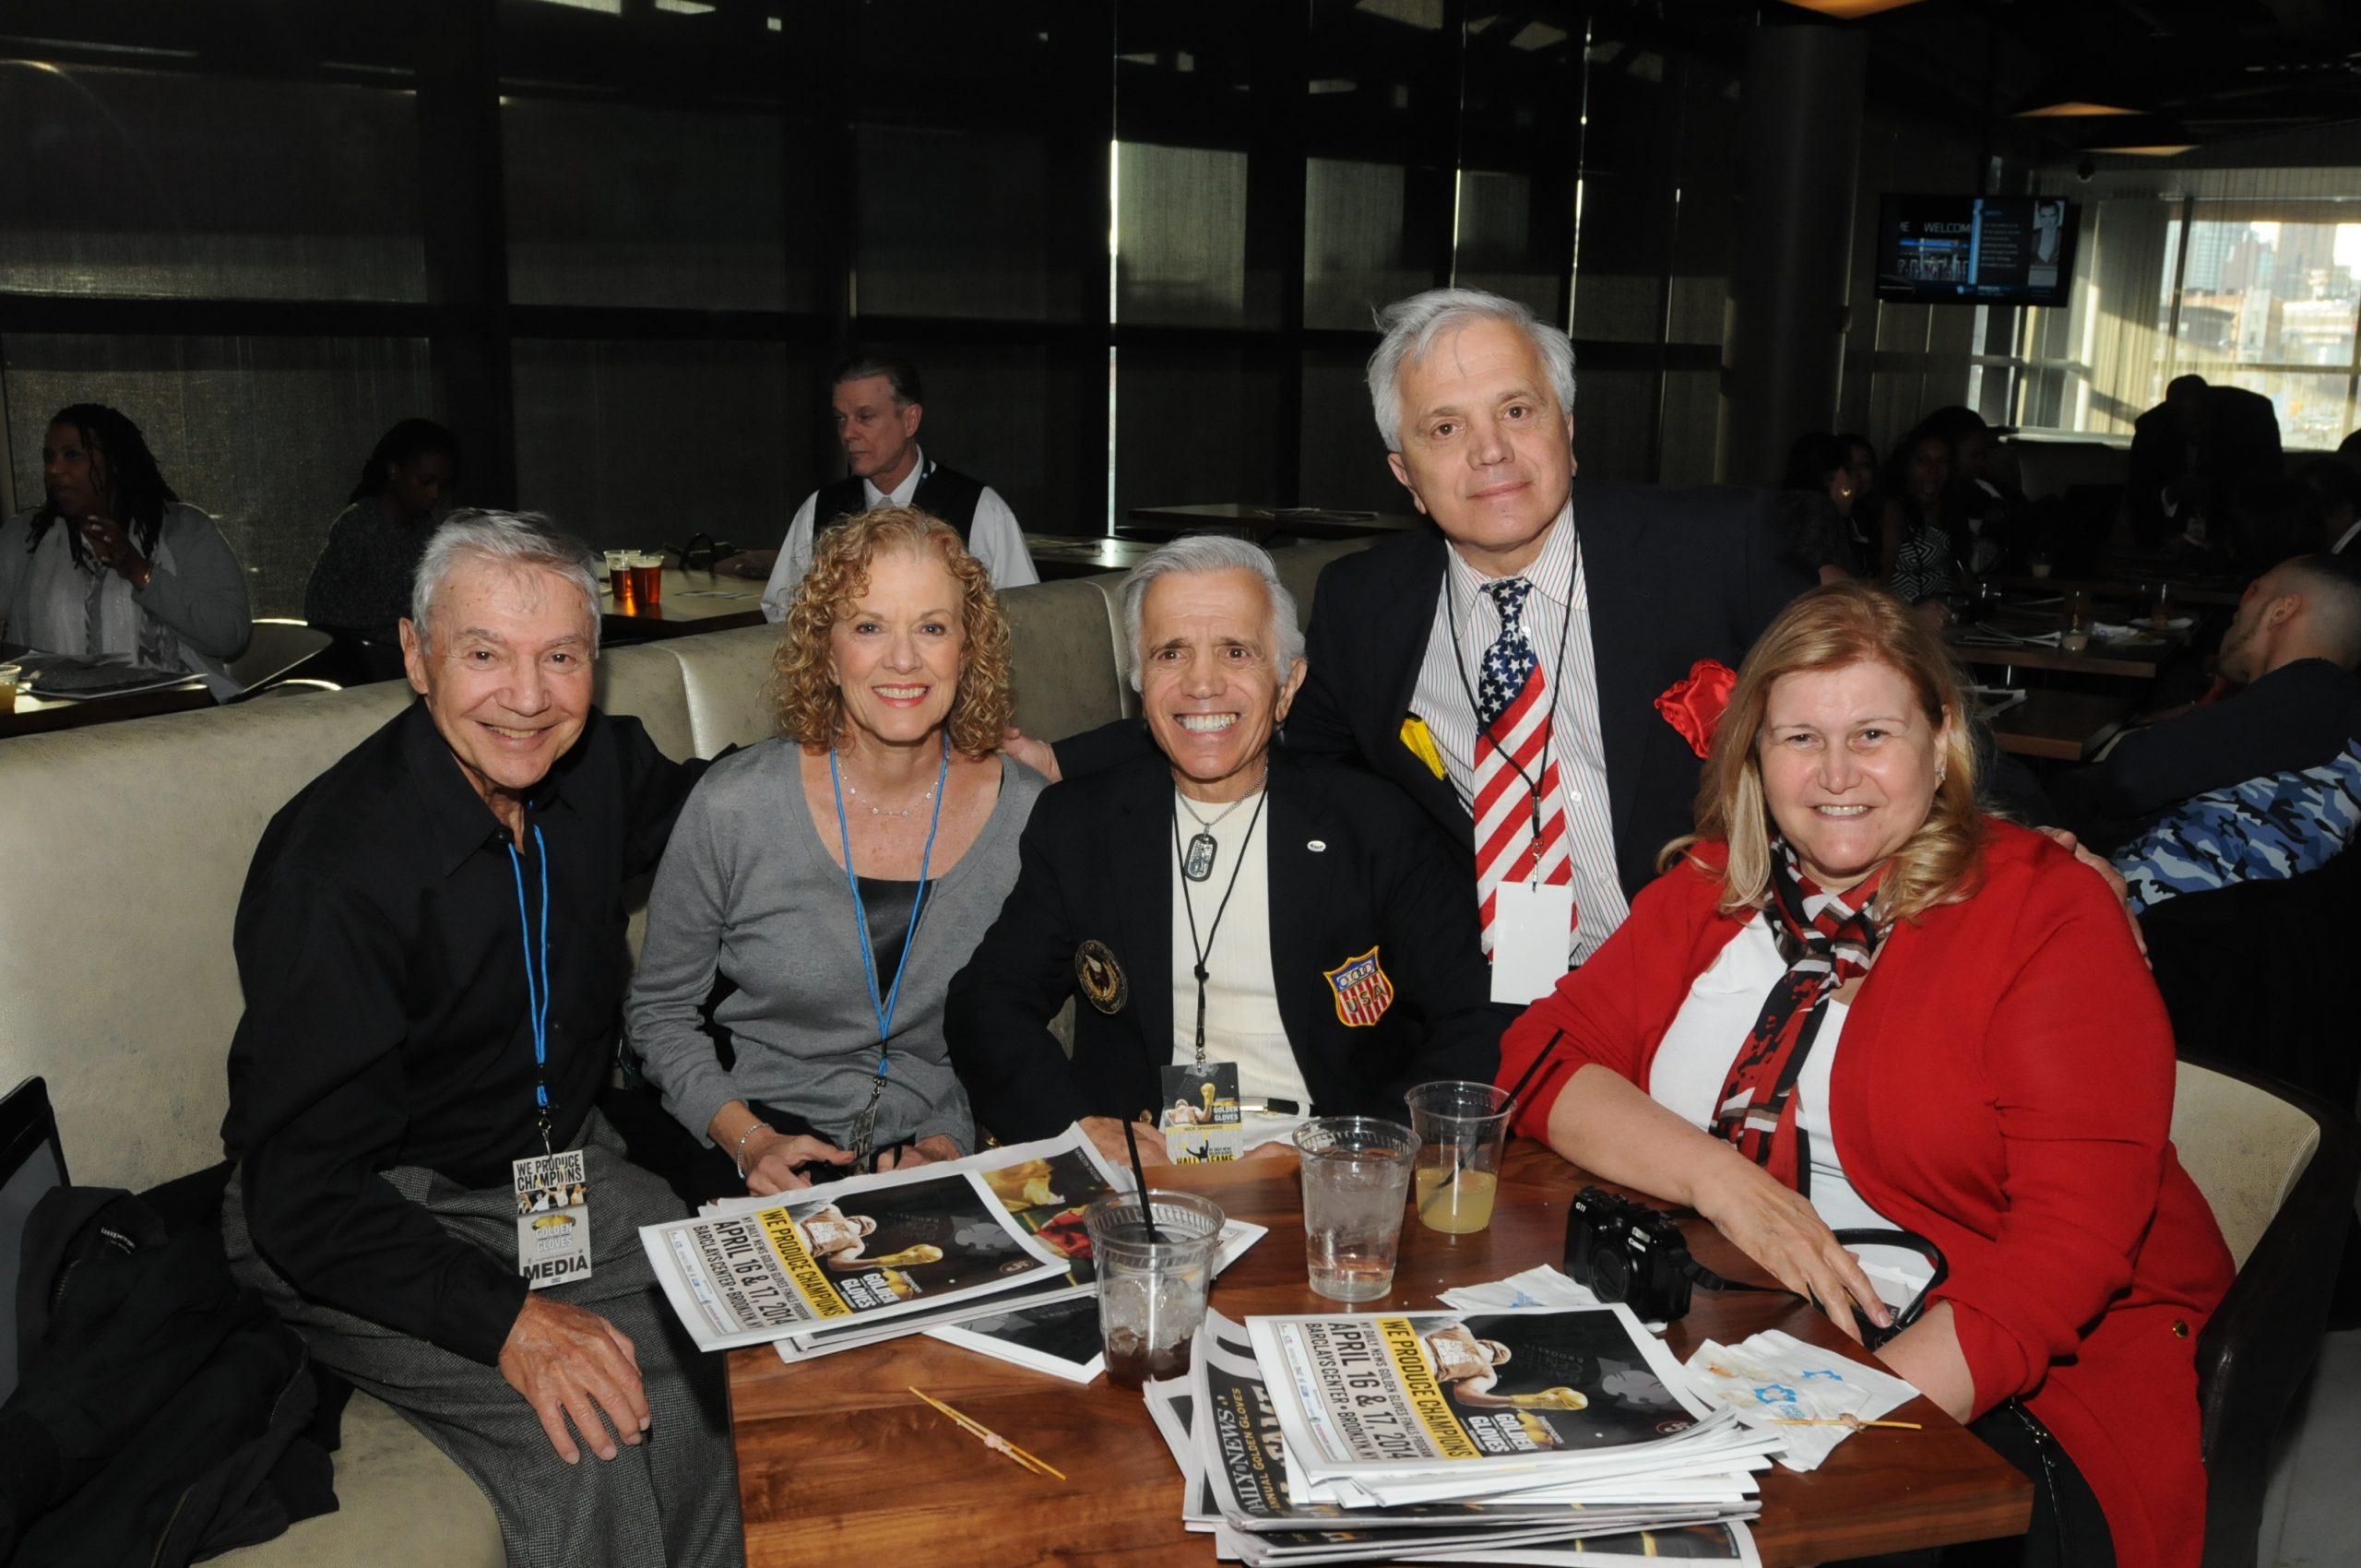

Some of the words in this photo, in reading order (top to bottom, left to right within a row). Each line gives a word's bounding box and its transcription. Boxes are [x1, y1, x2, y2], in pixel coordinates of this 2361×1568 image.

[1347, 983, 1387, 1014] USA
[1215, 1113, 1238, 1122] GLOVES
[516, 1161, 532, 1176] WE
[536, 1154, 580, 1174] PRODUCE
[517, 1168, 582, 1192] CHAMPIONS
[763, 1210, 788, 1228] WE
[1575, 1202, 1586, 1213] G11
[536, 1223, 572, 1240] GOLDEN
[713, 1220, 753, 1259] APRIL
[745, 1224, 761, 1238] DAILY
[753, 1239, 768, 1254] NEWS
[538, 1238, 573, 1252] GLOVES
[771, 1228, 812, 1272] PRODUCE
[524, 1255, 588, 1280] MEDIA
[732, 1259, 763, 1273] 16
[741, 1275, 769, 1286] &
[863, 1273, 901, 1305] GOLDEN
[795, 1270, 847, 1317] CHAMPIONS
[840, 1278, 877, 1309] GLOVES
[758, 1301, 798, 1325] 2014
[1363, 1330, 1380, 1347] DAILY
[1383, 1320, 1410, 1336] WE
[1327, 1322, 1371, 1367] APRIL
[1370, 1348, 1387, 1367] NEWS
[1391, 1339, 1437, 1396] PRODUCE
[1347, 1371, 1381, 1389] 16
[1378, 1368, 1398, 1393] GOLDEN
[1232, 1387, 1251, 1429] GLOVES
[1355, 1395, 1387, 1408] &
[1388, 1394, 1409, 1417] GLOVES
[1362, 1410, 1398, 1430] 17,
[1399, 1417, 1418, 1435] FINALS
[1417, 1399, 1474, 1458] CHAMPIONS
[1216, 1408, 1245, 1467] NEWS
[1468, 1416, 1511, 1454] GLOVES
[1494, 1413, 1539, 1452] GOLDEN
[1244, 1431, 1265, 1471] GOLDEN
[1360, 1449, 1382, 1461] NY
[1373, 1431, 1418, 1460] 2014
[1410, 1432, 1435, 1458] PROGRAM
